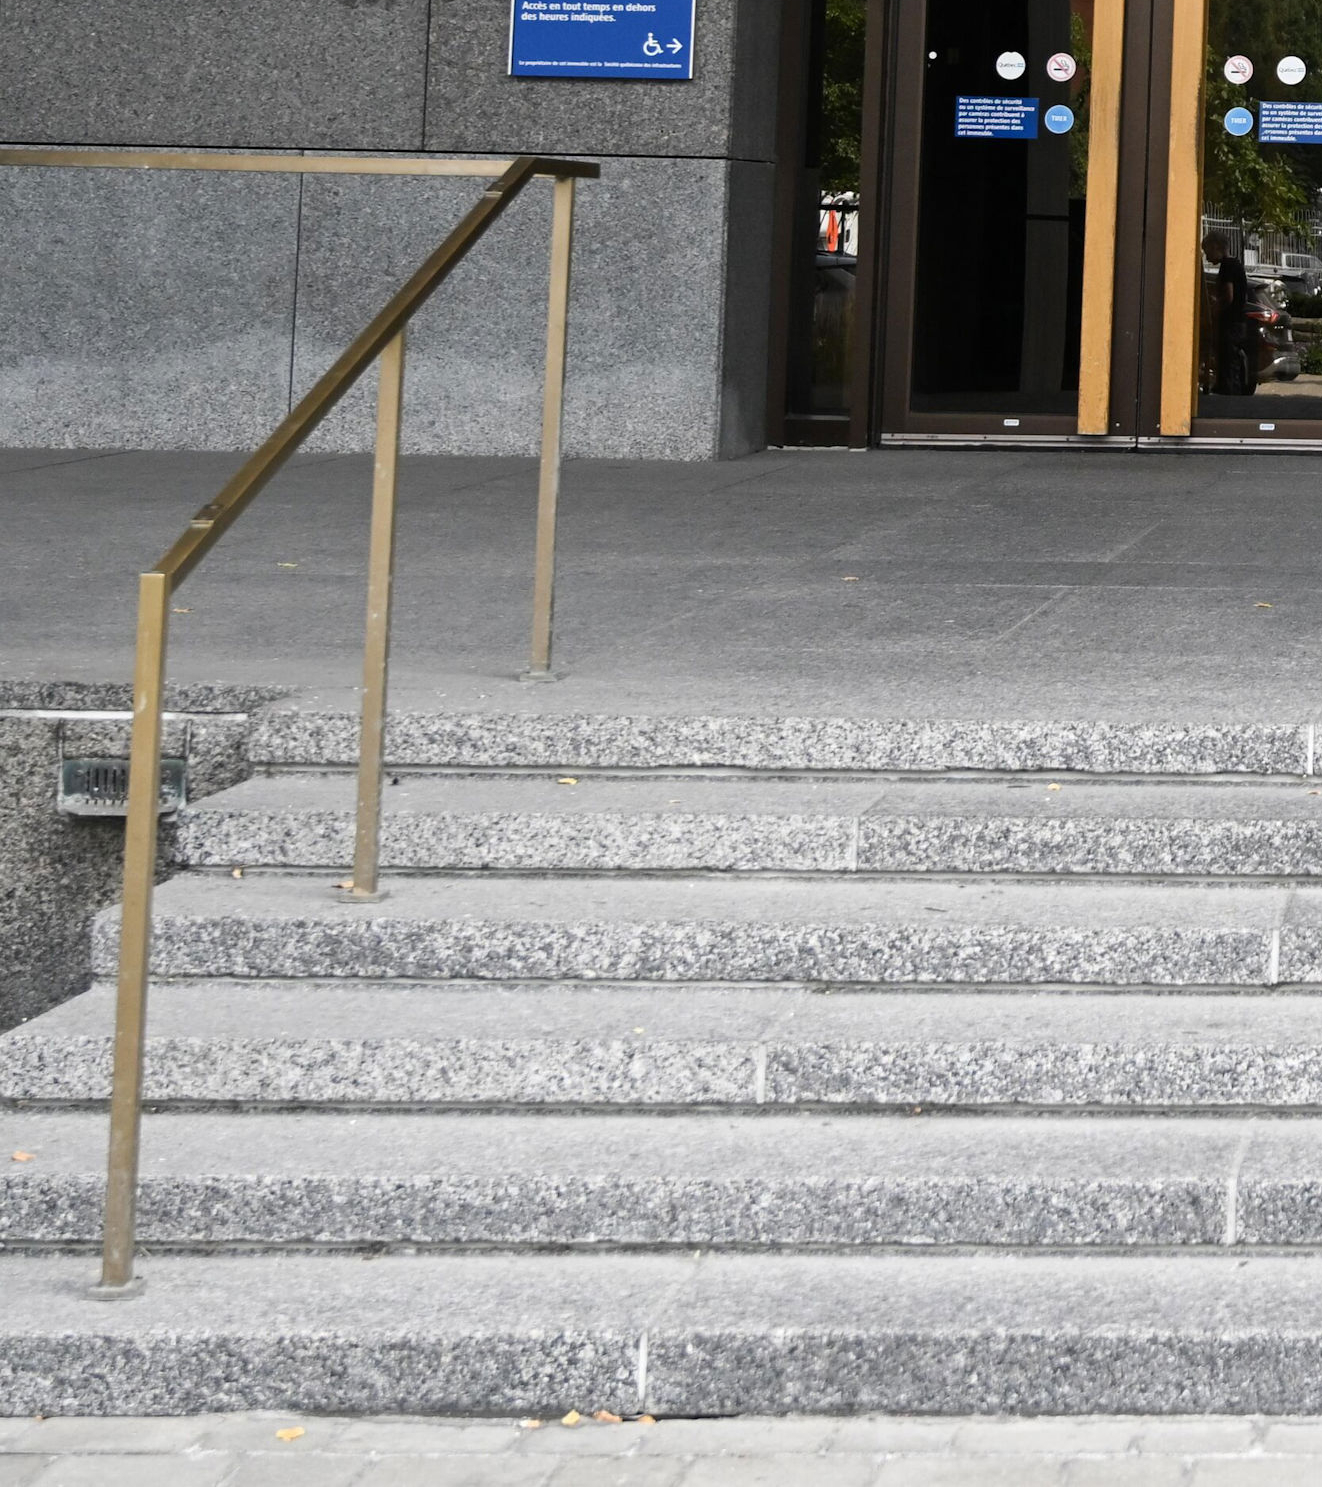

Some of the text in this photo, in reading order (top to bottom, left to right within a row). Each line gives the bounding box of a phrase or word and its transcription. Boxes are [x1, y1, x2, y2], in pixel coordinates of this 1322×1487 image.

[522, 1, 547, 10] Accès
[583, 3, 610, 12] temps
[626, 3, 656, 12] dehors
[521, 12, 616, 23] des heures indiquées.
